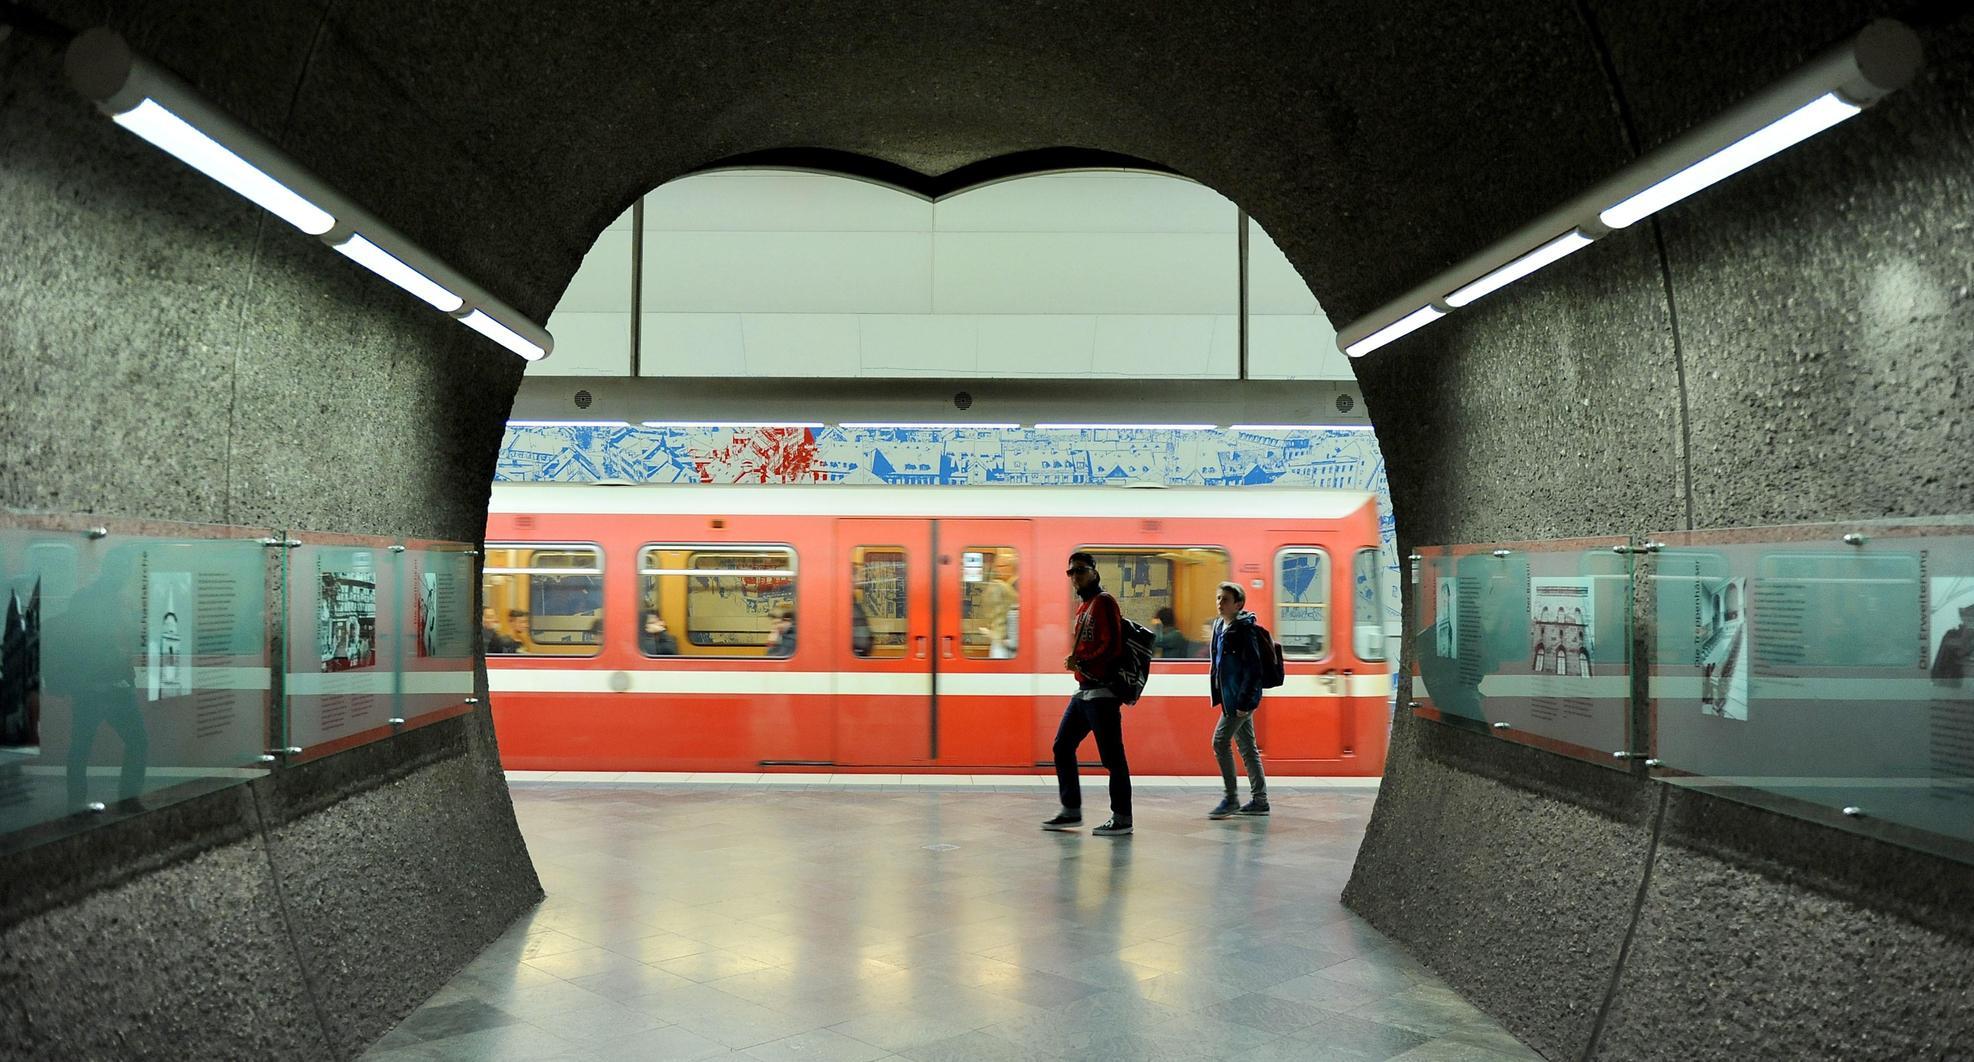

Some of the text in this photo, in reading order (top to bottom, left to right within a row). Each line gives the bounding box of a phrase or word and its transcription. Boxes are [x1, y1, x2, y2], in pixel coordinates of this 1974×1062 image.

[1694, 561, 1702, 645] Treppenhäuser
[1918, 550, 1928, 671] Die Erweiterung
